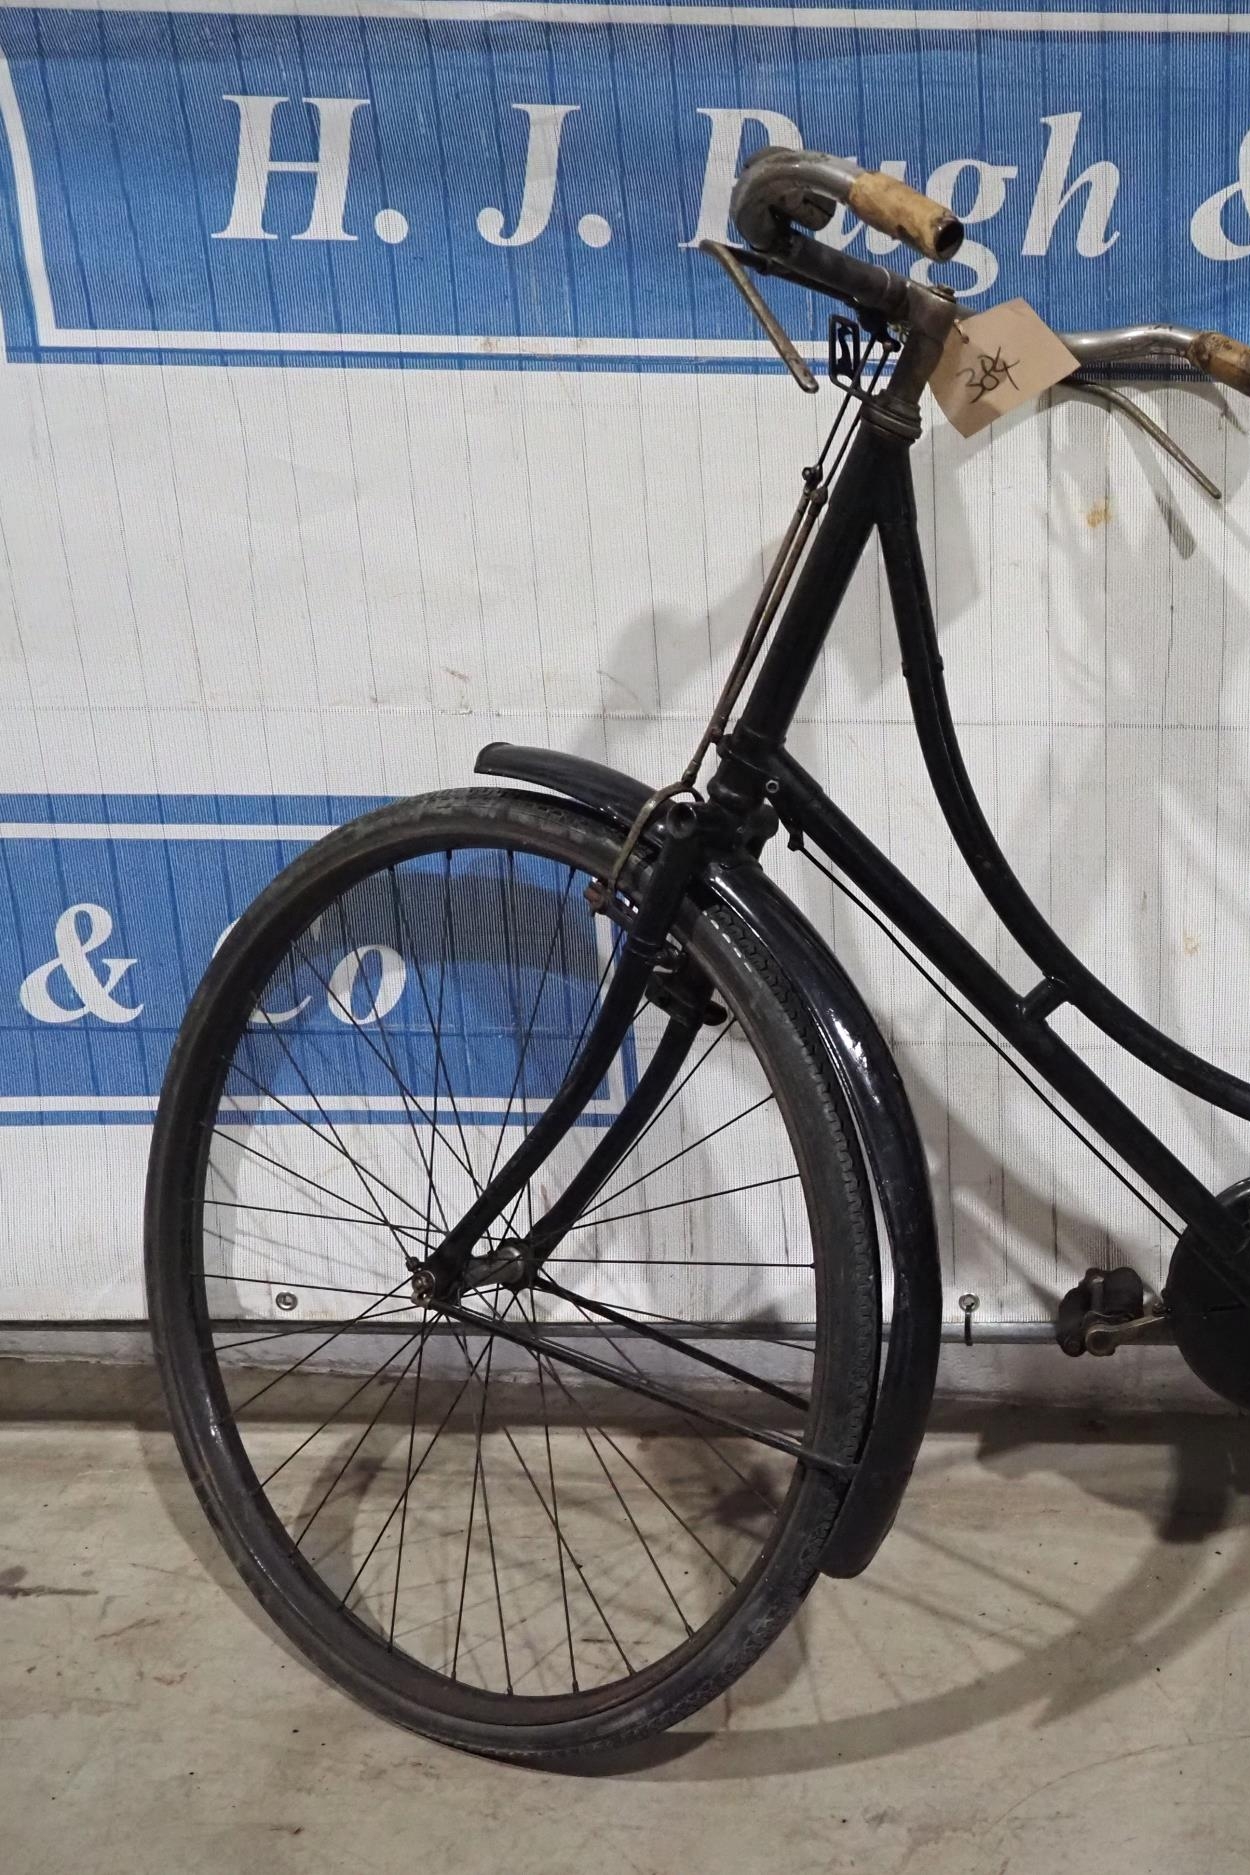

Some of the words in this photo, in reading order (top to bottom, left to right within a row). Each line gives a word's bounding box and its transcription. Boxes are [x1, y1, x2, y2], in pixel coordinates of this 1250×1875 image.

[210, 94, 408, 245] H.
[475, 103, 613, 248] J.
[956, 346, 1021, 404] 384
[19, 902, 145, 1024] &
